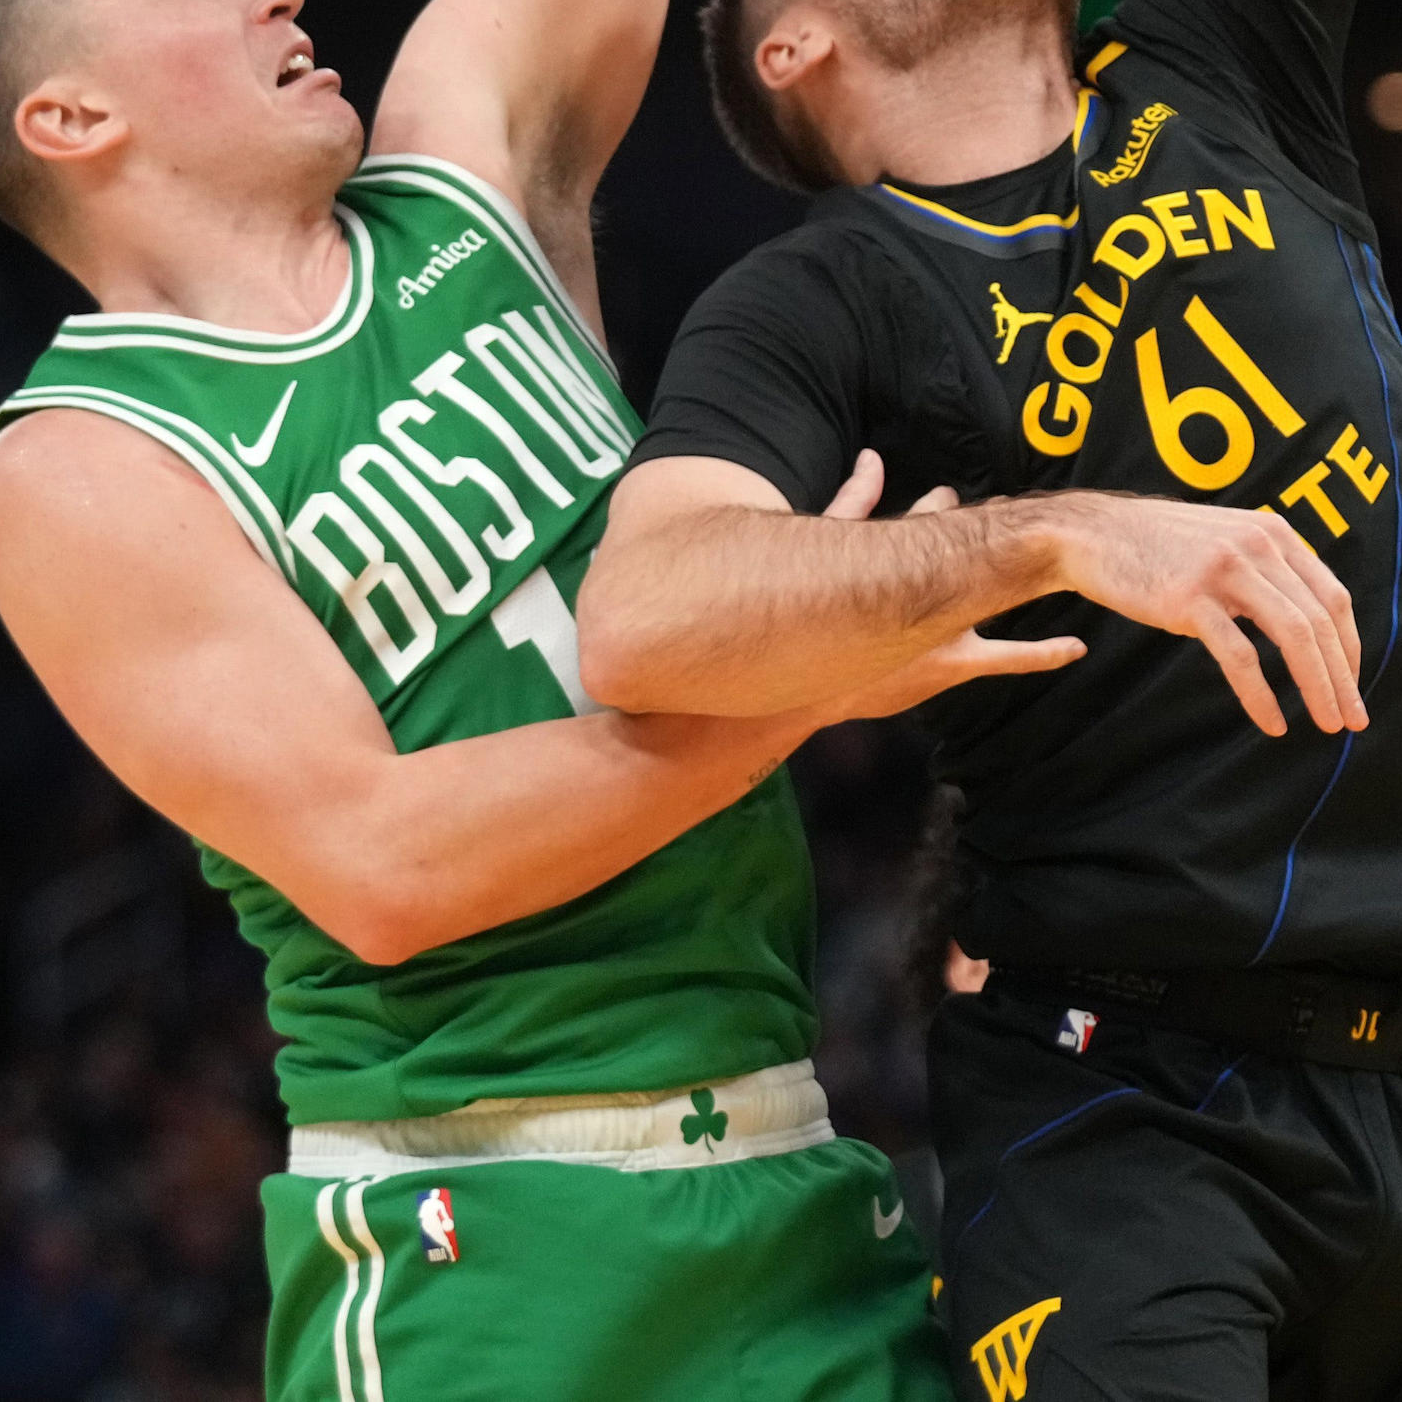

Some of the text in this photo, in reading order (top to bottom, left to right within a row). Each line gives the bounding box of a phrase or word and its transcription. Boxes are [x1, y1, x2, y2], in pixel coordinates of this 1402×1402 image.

[1089, 102, 1179, 188] Rakuten
[397, 228, 488, 310] Amica
[1022, 188, 1276, 457] GOLDEN
[1135, 294, 1306, 490] 61
[285, 305, 637, 686] BOSTON
[1255, 423, 1390, 556] TE
[490, 548, 608, 718] 1
[428, 1247, 448, 1262] NBA
